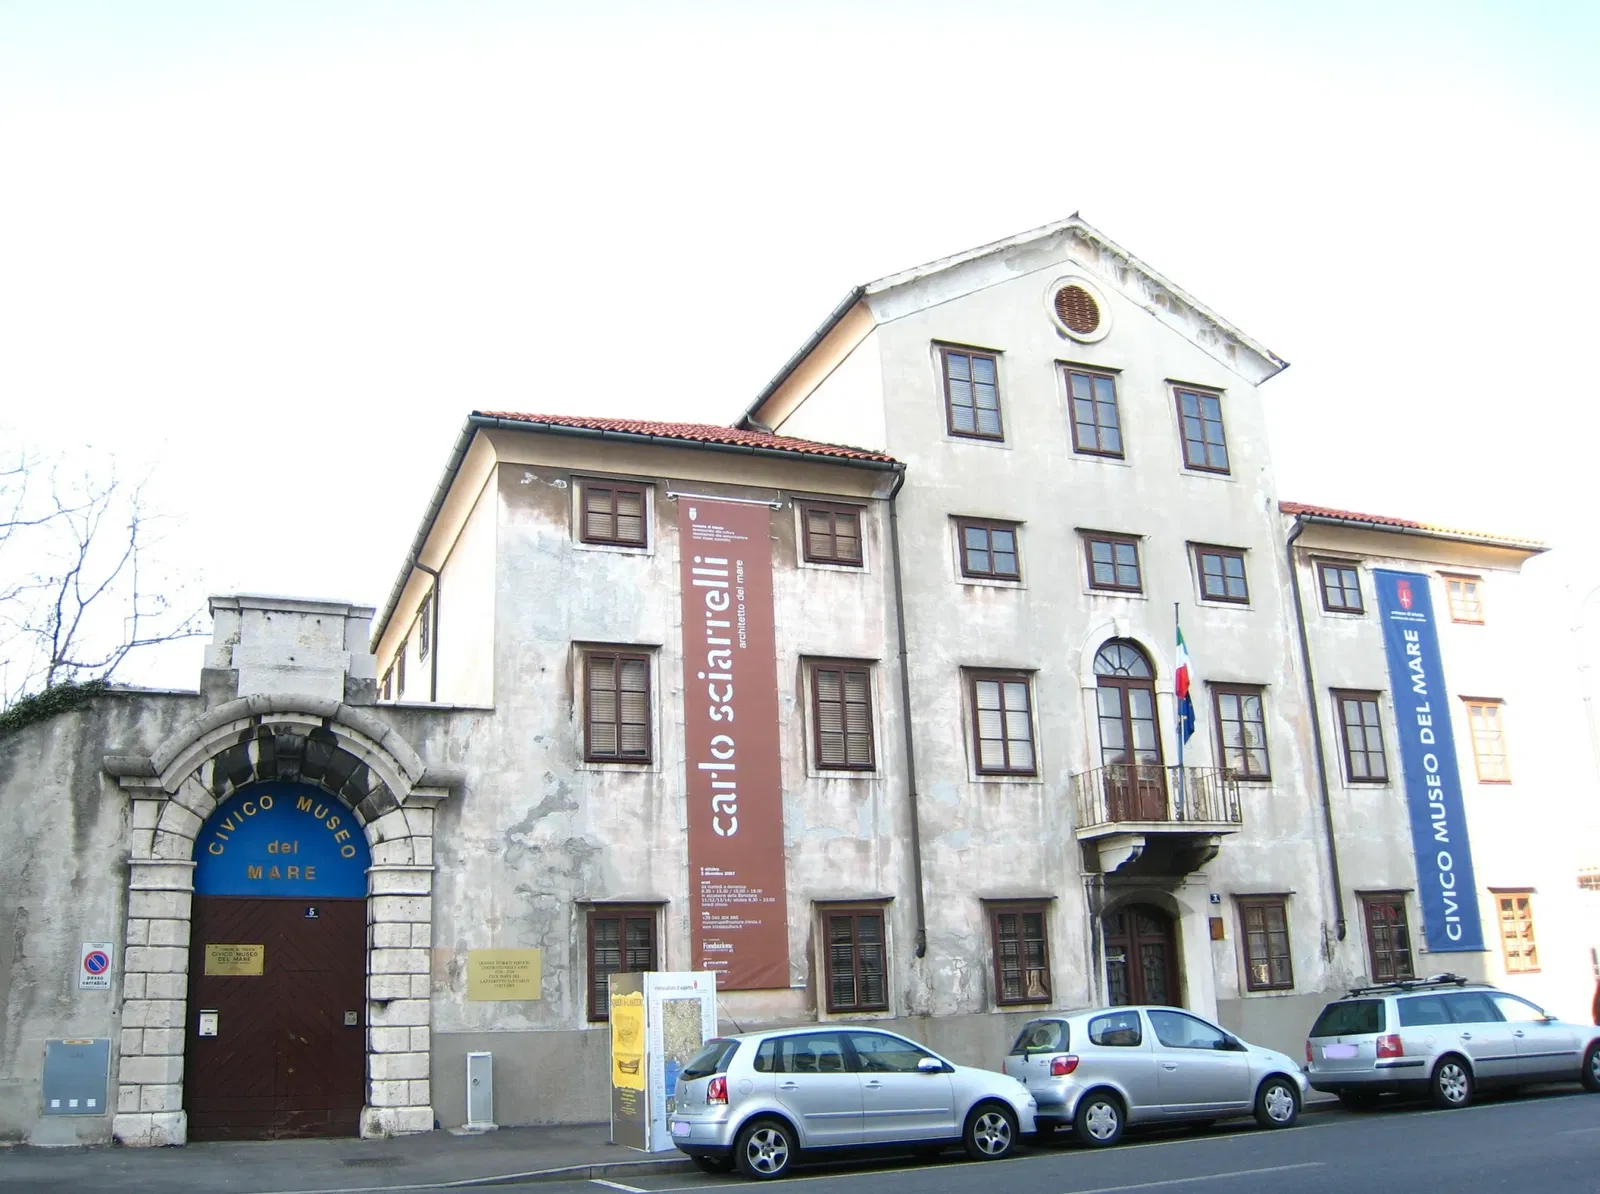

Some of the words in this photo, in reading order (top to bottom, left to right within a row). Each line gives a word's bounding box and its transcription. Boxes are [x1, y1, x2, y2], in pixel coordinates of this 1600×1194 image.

[736, 559, 745, 584] mare
[736, 586, 745, 601] del
[692, 555, 734, 722] sciarrelli
[736, 604, 747, 649] architetto
[1403, 629, 1429, 695] MARE
[1416, 701, 1436, 745] DEL
[698, 734, 738, 837] carlo
[1423, 753, 1450, 843] MUSEO
[208, 795, 274, 856] CIVICO
[296, 795, 356, 859] MUSEO
[267, 840, 298, 854] del
[247, 865, 316, 880] MARE
[308, 907, 315, 916] 5
[1437, 850, 1462, 942] CIVICO
[702, 941, 734, 949] Fondazione
